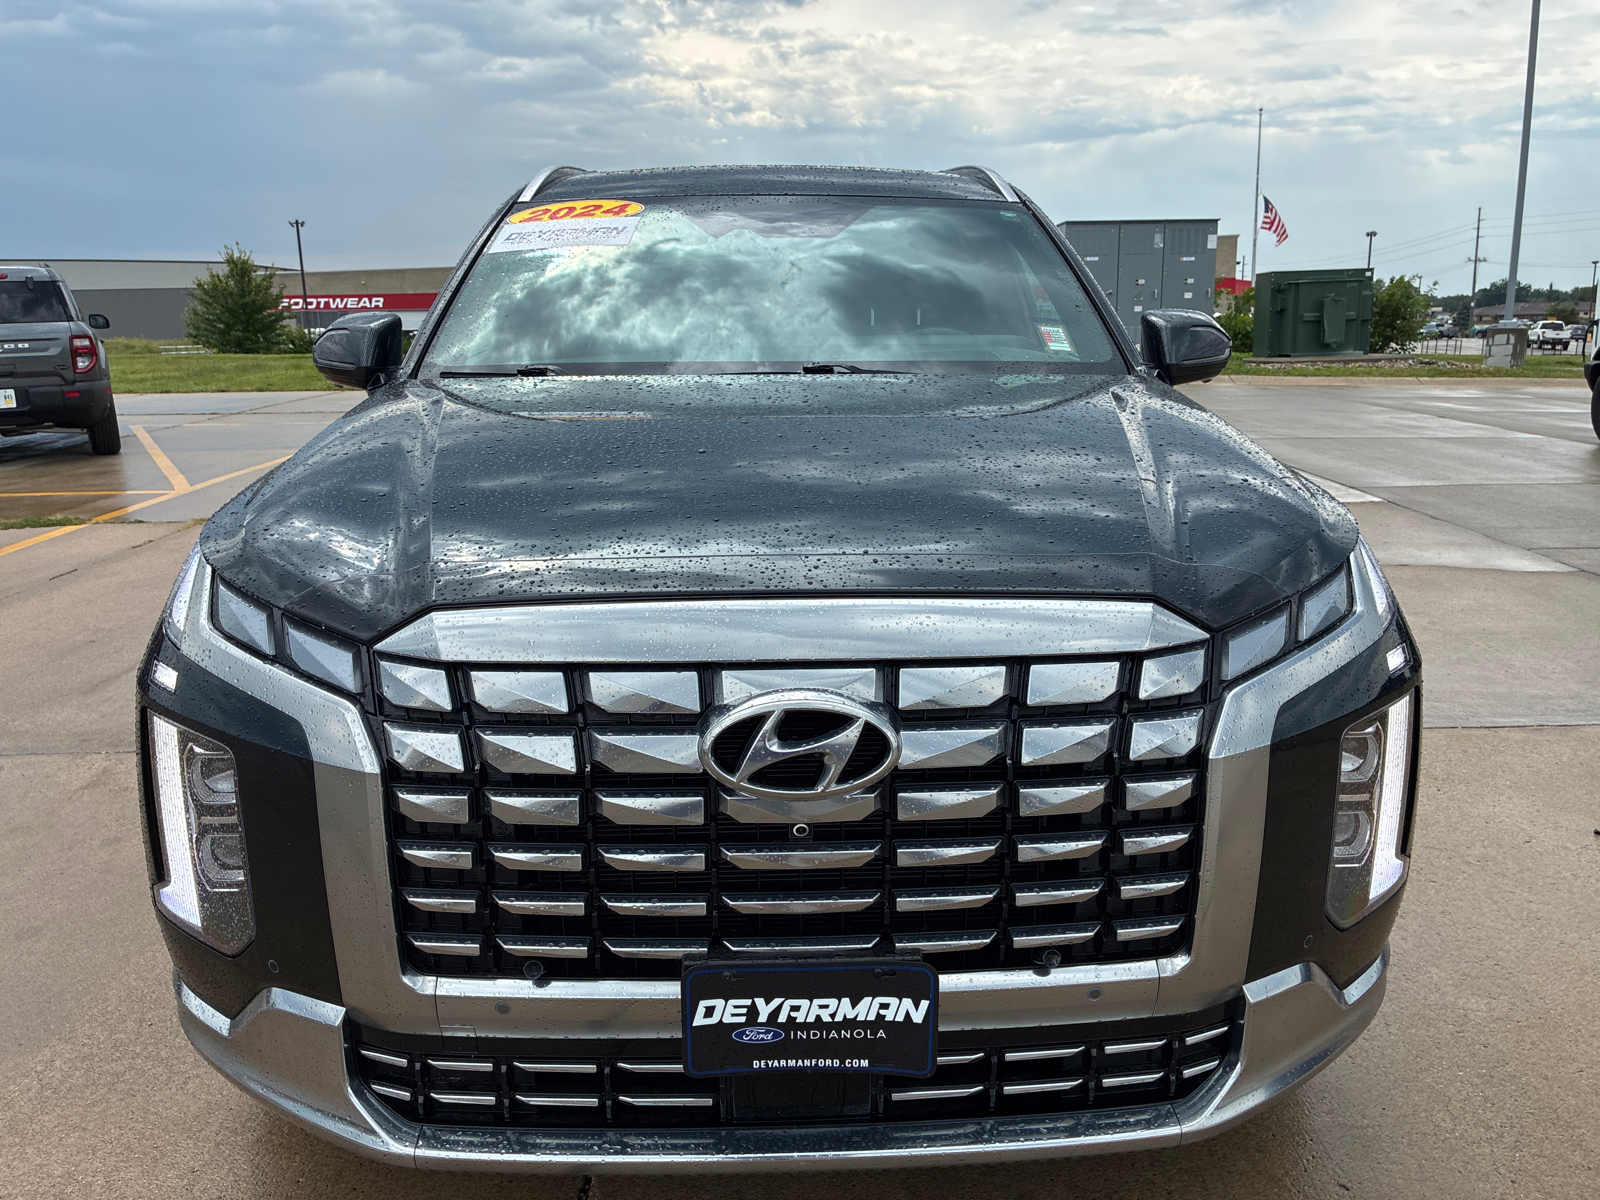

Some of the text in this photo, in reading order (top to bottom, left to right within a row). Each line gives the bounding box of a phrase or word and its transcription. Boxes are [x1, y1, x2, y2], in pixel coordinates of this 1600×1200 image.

[518, 203, 632, 223] 2024
[278, 297, 384, 309] FOOTWEAR
[692, 996, 930, 1027] DEYARMAN
[740, 1028, 887, 1041] Ford INDIANOLA
[753, 1058, 869, 1068] DEYARMANFORD.COM
